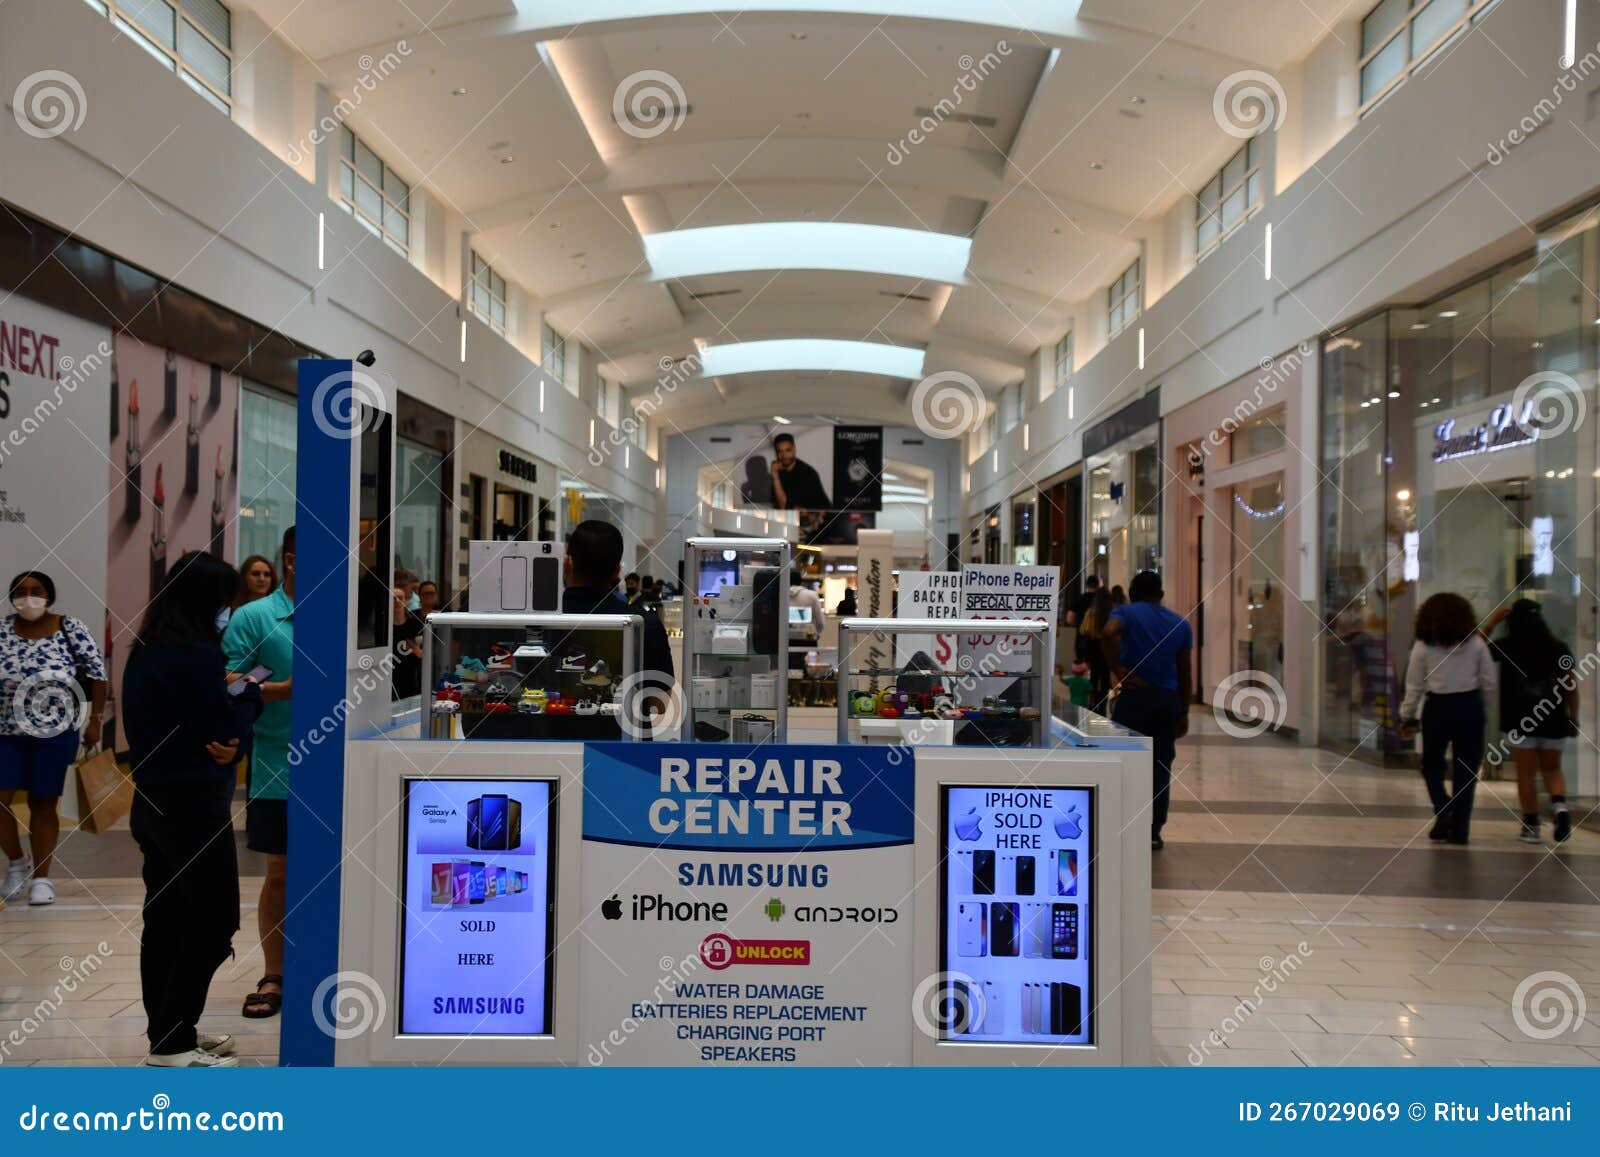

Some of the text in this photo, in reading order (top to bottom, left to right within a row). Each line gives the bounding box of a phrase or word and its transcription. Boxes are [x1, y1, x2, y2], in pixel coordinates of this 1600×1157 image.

[965, 571, 1055, 590] iPhone Repair
[913, 590, 944, 603] BACK
[966, 595, 1051, 609] SPECIAL OFFER
[660, 757, 844, 795] REPAIR
[985, 792, 1053, 808] IPHONE
[648, 798, 853, 836] CENTER
[994, 813, 1043, 829] SOLD
[996, 834, 1042, 850] HERE
[678, 862, 829, 888] SAMSUNG
[631, 894, 728, 922] iPhone
[460, 920, 496, 932] SOLD
[457, 954, 495, 966] HERE
[736, 945, 806, 960] UNLOCK
[675, 983, 825, 1000] WATER DAMAGE
[433, 996, 525, 1015] SAMSUNG
[631, 1003, 867, 1021] BATTERIES REPLACEMENT
[676, 1024, 826, 1041] CHARGING PORT
[700, 1046, 796, 1062] SPEAKERS
